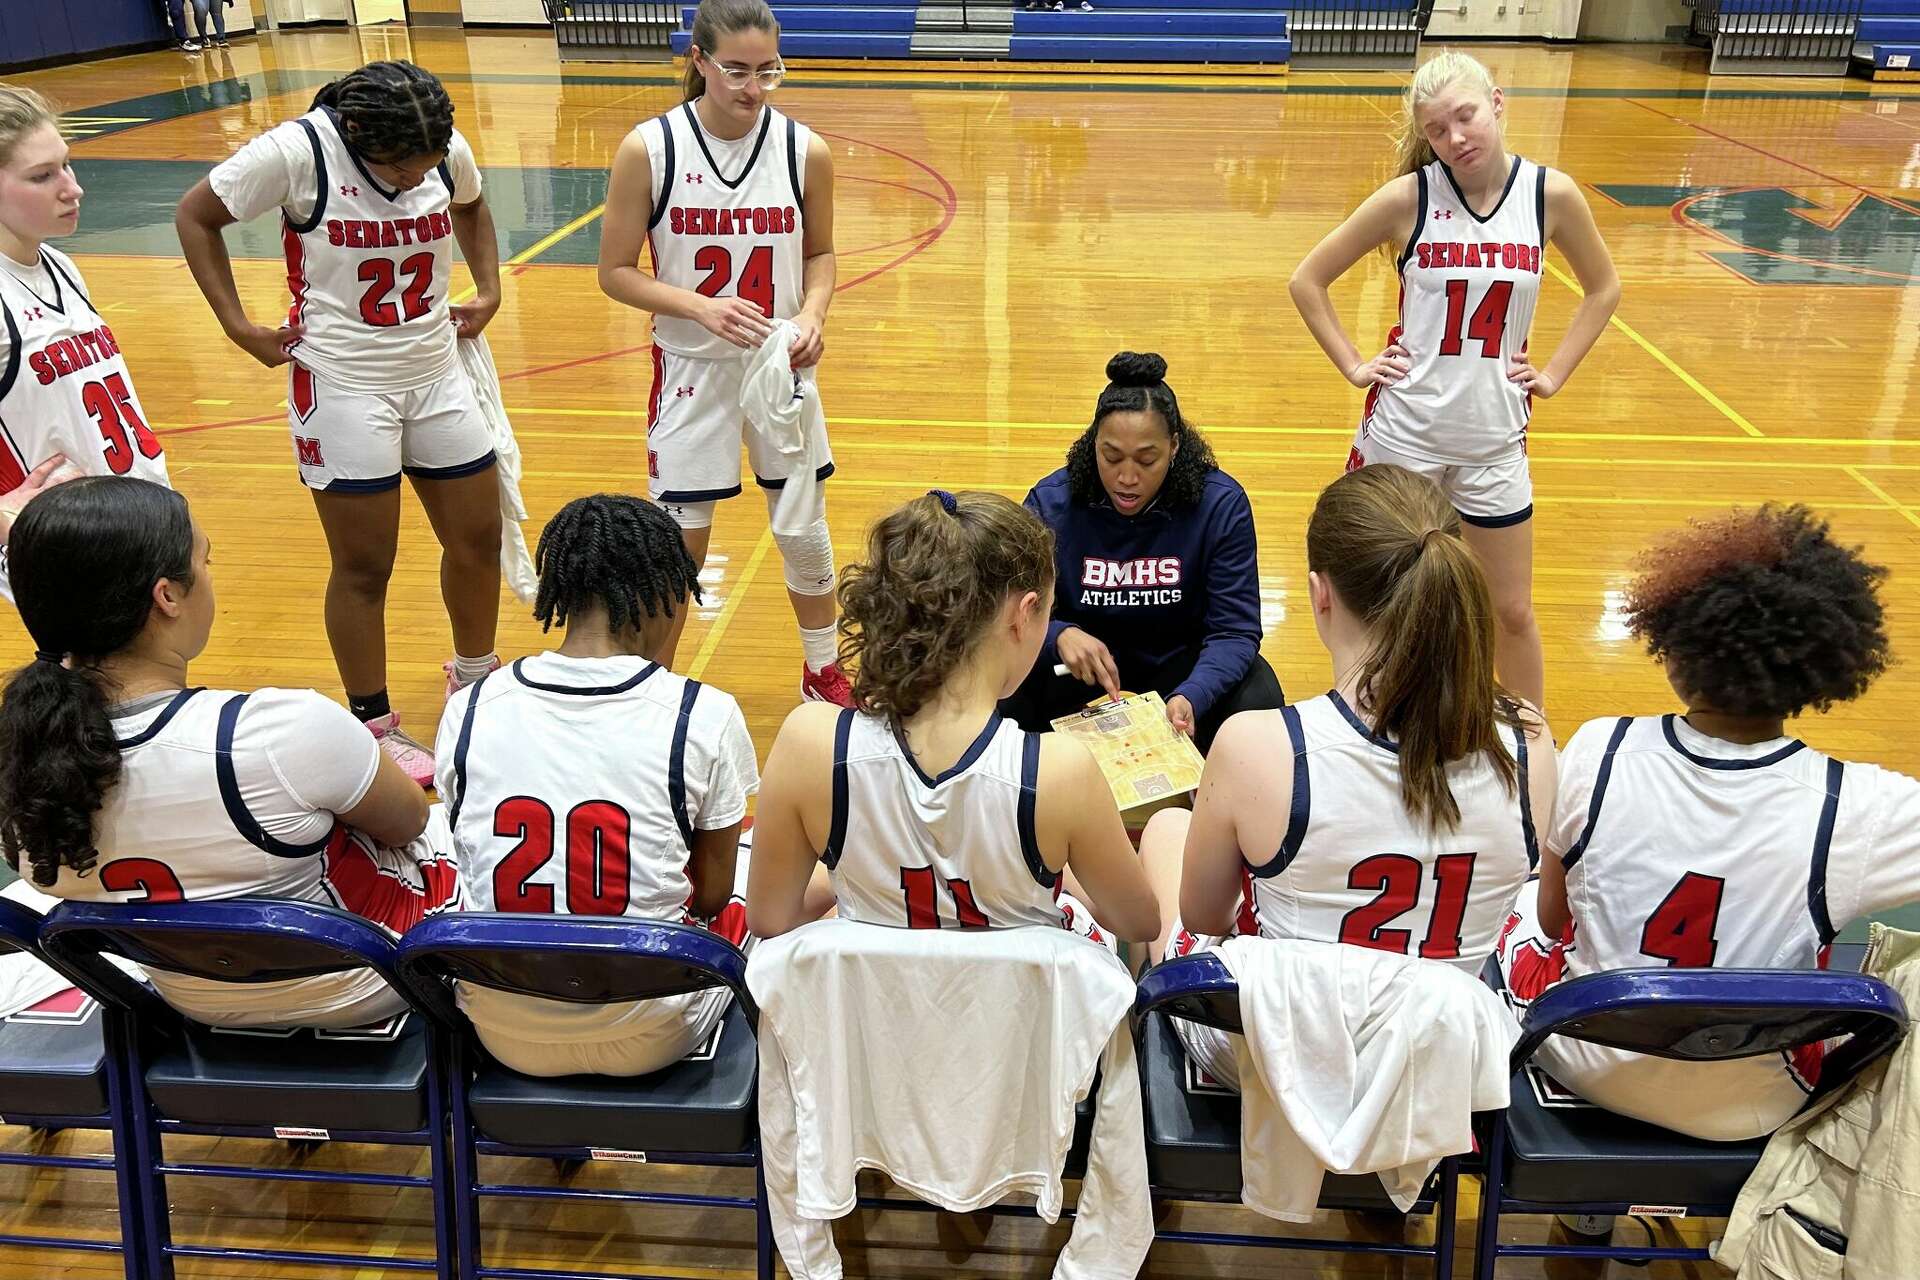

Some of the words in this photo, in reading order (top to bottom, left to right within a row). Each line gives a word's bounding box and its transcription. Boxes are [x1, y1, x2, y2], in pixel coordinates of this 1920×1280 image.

[326, 209, 452, 248] SENATORS
[668, 206, 795, 235] SENATORS
[358, 251, 435, 327] 22
[694, 245, 775, 319] 24
[1416, 242, 1540, 274] SENATORS
[1439, 279, 1514, 358] 14
[82, 371, 163, 474] 35
[295, 435, 325, 467] M
[1080, 589, 1182, 606] ATHLETICS
[1081, 557, 1182, 588] BMHS
[493, 795, 631, 916] 20
[1338, 852, 1477, 959] 21
[1639, 870, 1726, 968] 4
